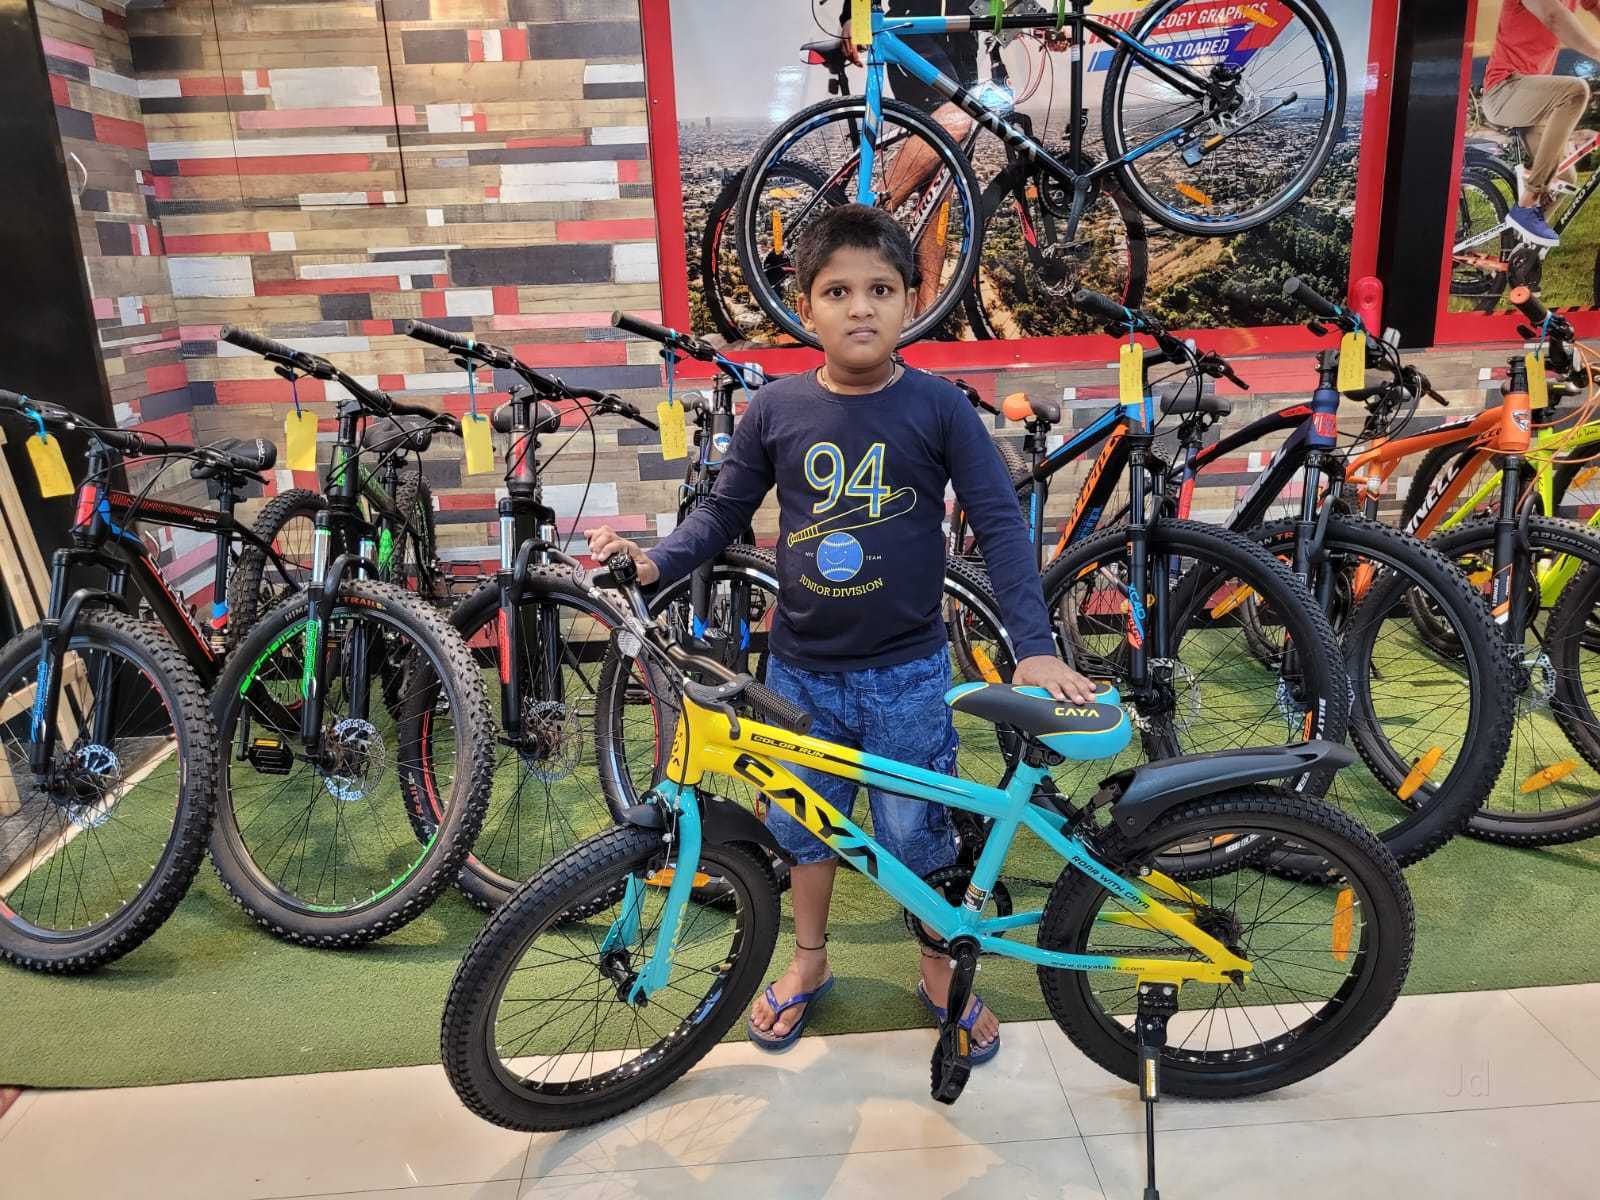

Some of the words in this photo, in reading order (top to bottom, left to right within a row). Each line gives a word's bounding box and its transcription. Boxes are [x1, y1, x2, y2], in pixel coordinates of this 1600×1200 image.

[1174, 38, 1230, 58] LOADED
[804, 441, 891, 518] 94
[799, 573, 831, 597] JUNIOR
[832, 577, 884, 598] DIVISION
[1054, 707, 1100, 719] CAYA
[753, 735, 796, 751] COLOR
[798, 746, 825, 759] RUN
[733, 752, 879, 880] CAYA
[1072, 855, 1100, 876] ROAR
[1100, 873, 1125, 893] WITH
[1124, 891, 1151, 910] CAYA
